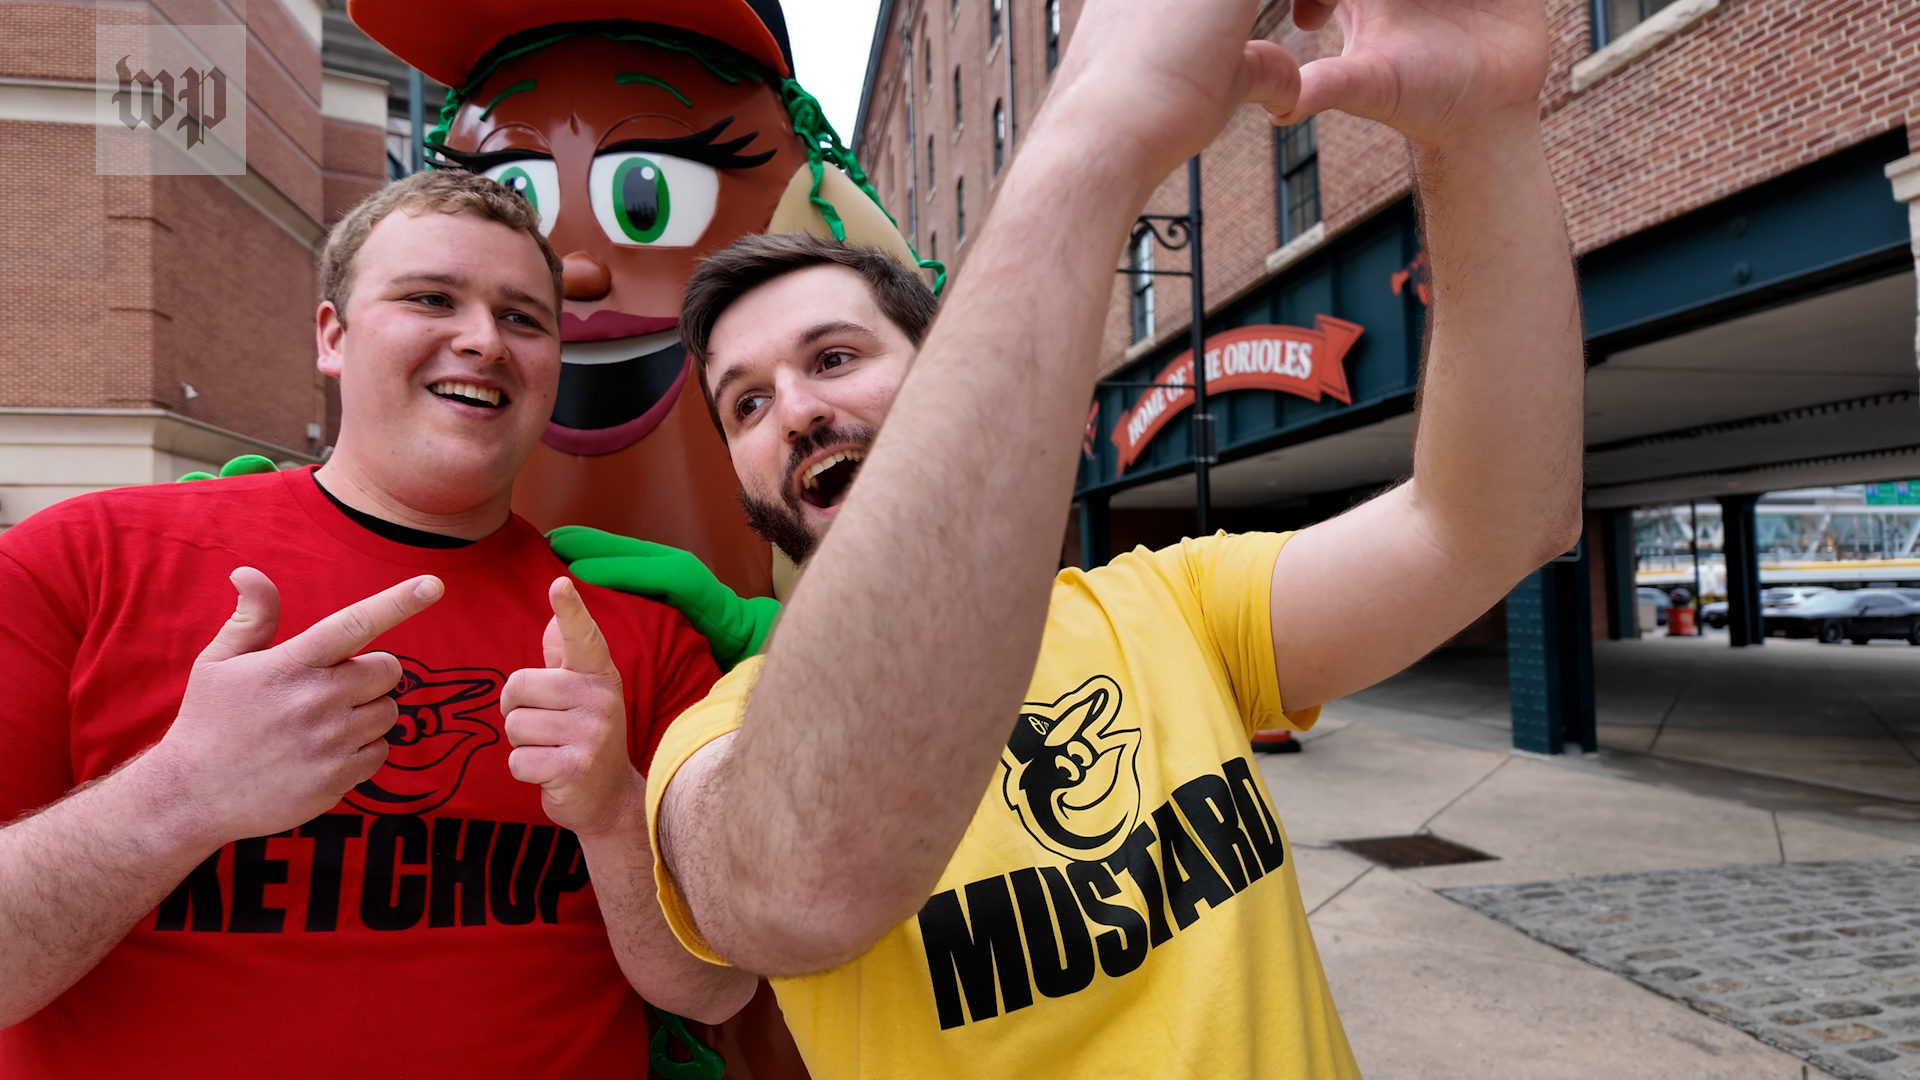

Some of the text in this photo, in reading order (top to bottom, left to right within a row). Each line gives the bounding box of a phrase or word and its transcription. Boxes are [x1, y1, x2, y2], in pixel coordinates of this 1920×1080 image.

[1127, 338, 1313, 447] HOME OF HE ORIOLES
[917, 756, 1284, 1031] MUSTARD
